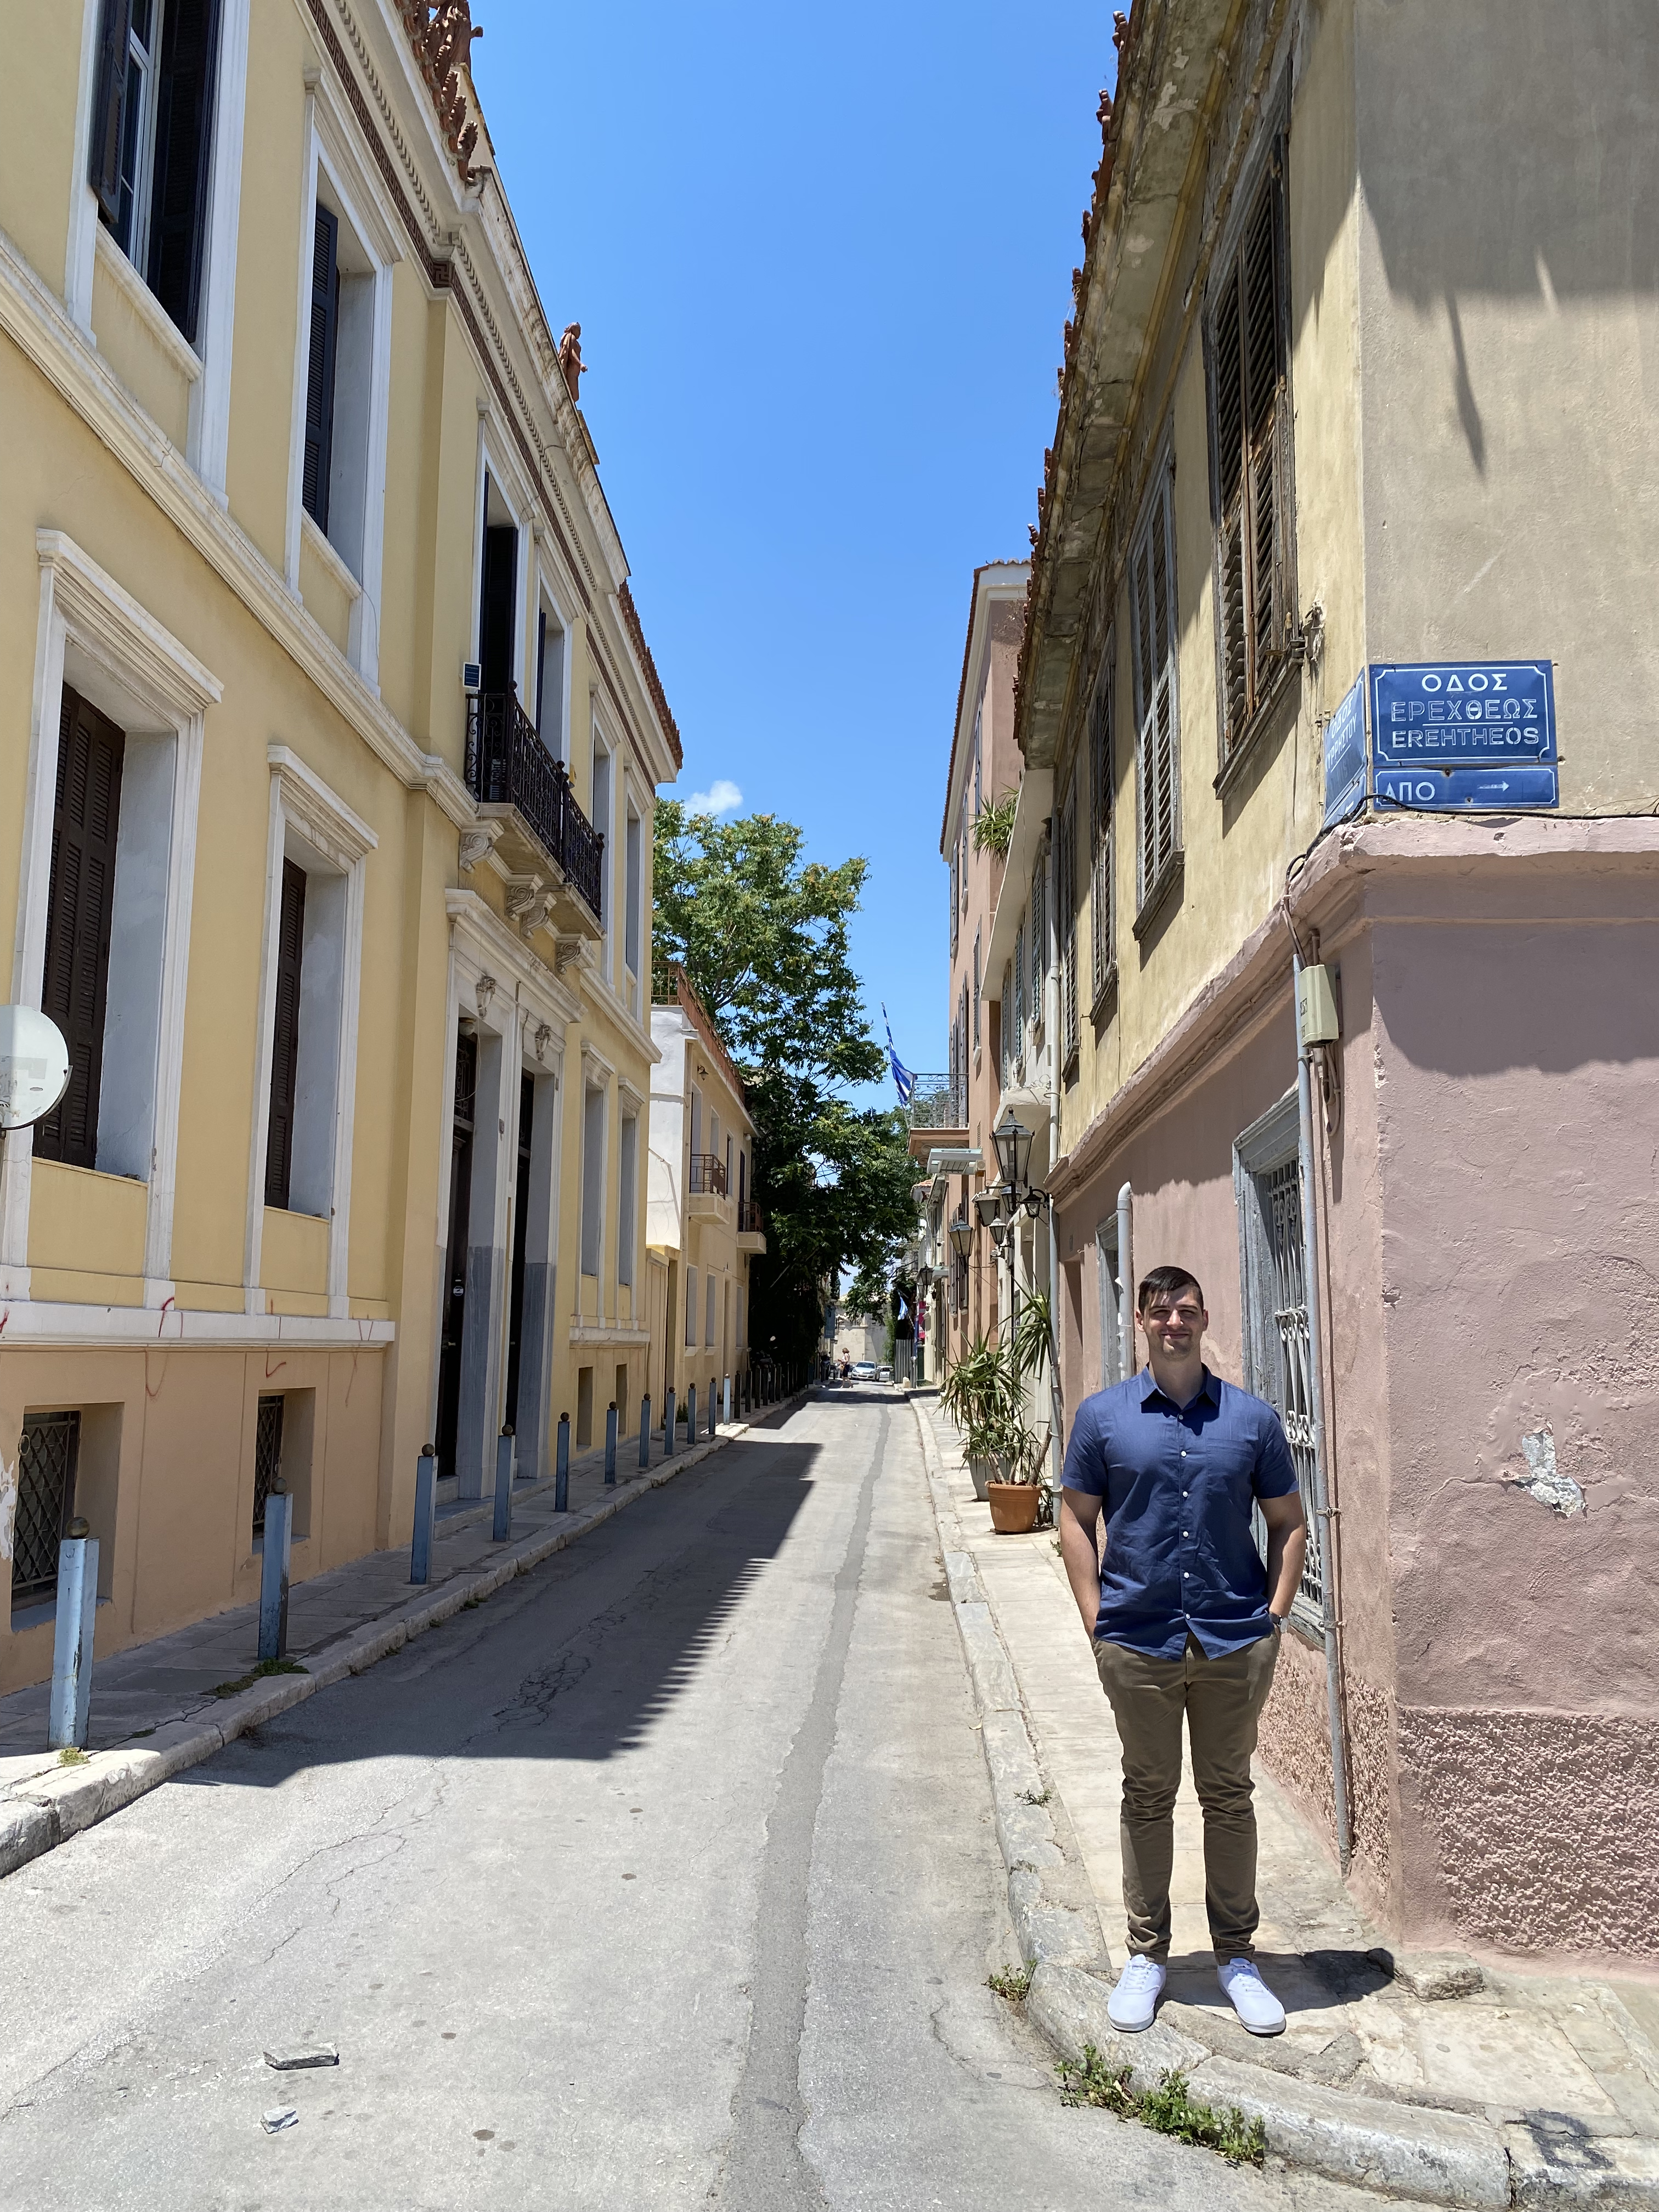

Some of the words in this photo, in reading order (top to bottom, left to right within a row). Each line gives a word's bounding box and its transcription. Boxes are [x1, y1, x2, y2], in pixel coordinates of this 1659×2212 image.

[1421, 673, 1508, 692] ΟΔΟΣ
[1331, 696, 1353, 739] ΟΔΟΣ
[1391, 698, 1538, 722] ΕΡΕΧΘΕΩΣ
[1392, 727, 1539, 748] EREHTHEOS
[1383, 782, 1436, 802] ΑΠΟ
